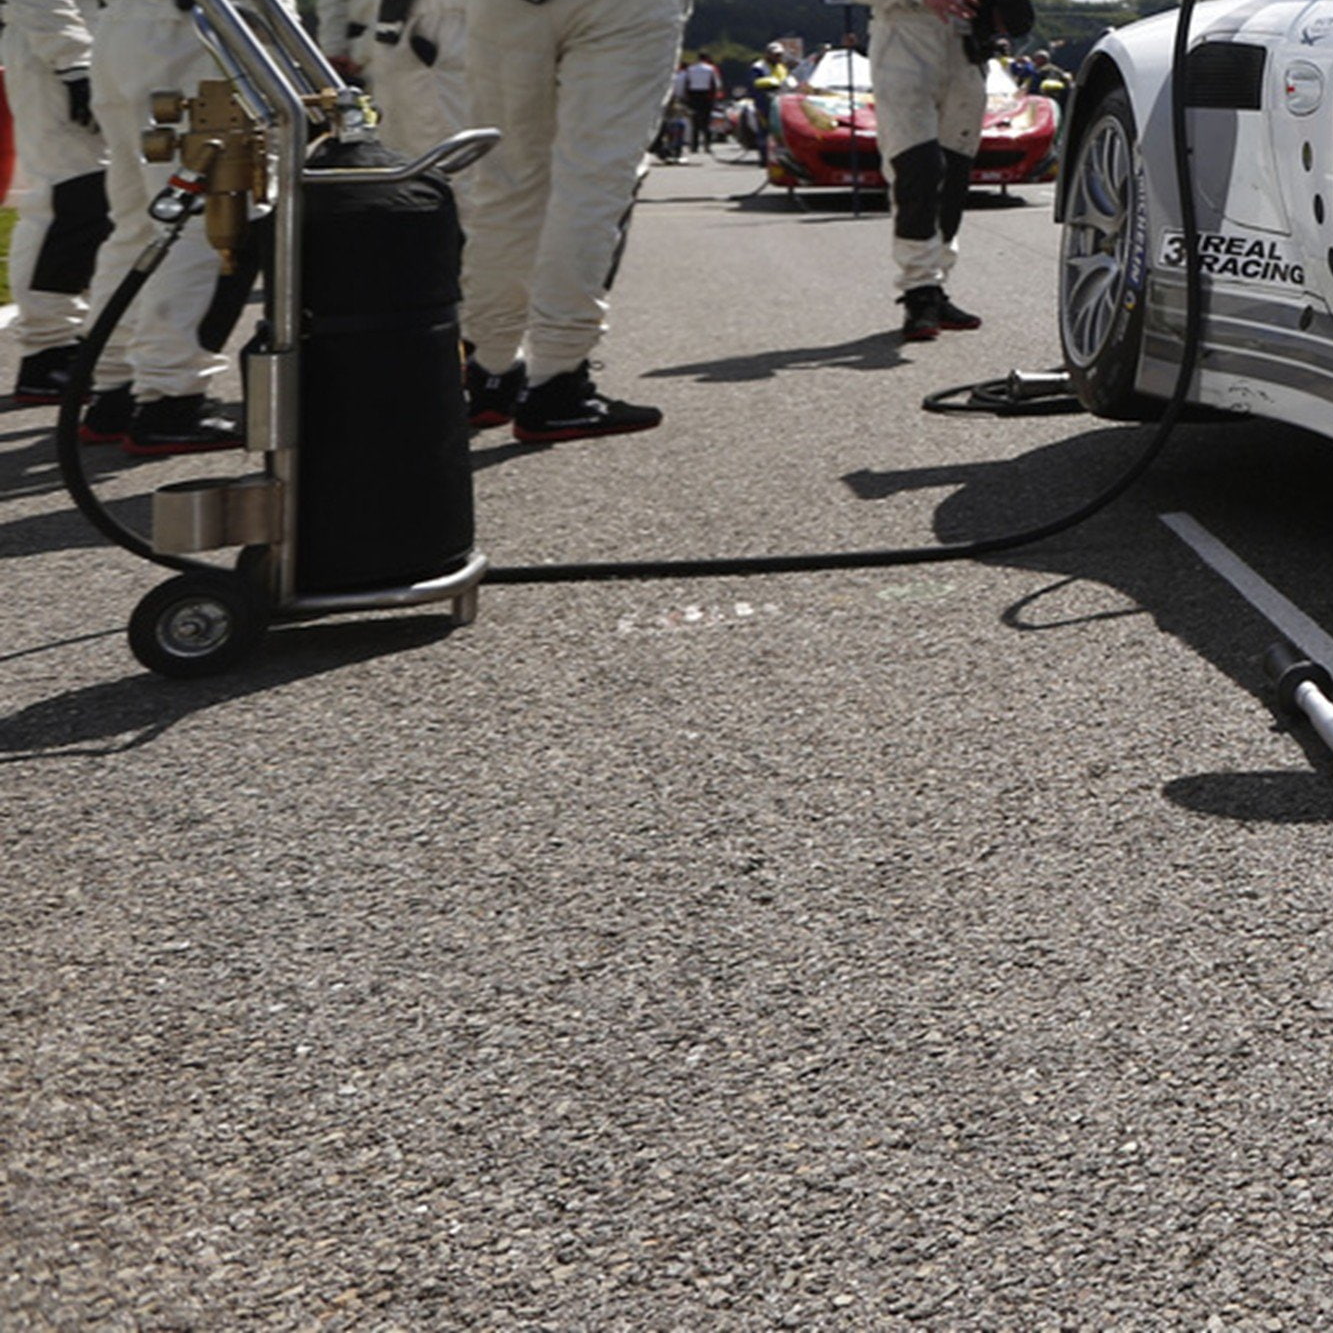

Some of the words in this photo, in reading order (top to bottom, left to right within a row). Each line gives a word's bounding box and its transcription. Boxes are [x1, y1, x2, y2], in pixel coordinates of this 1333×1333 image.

[1164, 236, 1188, 265] 3
[1202, 234, 1283, 261] REAL
[1199, 253, 1306, 285] RACING
